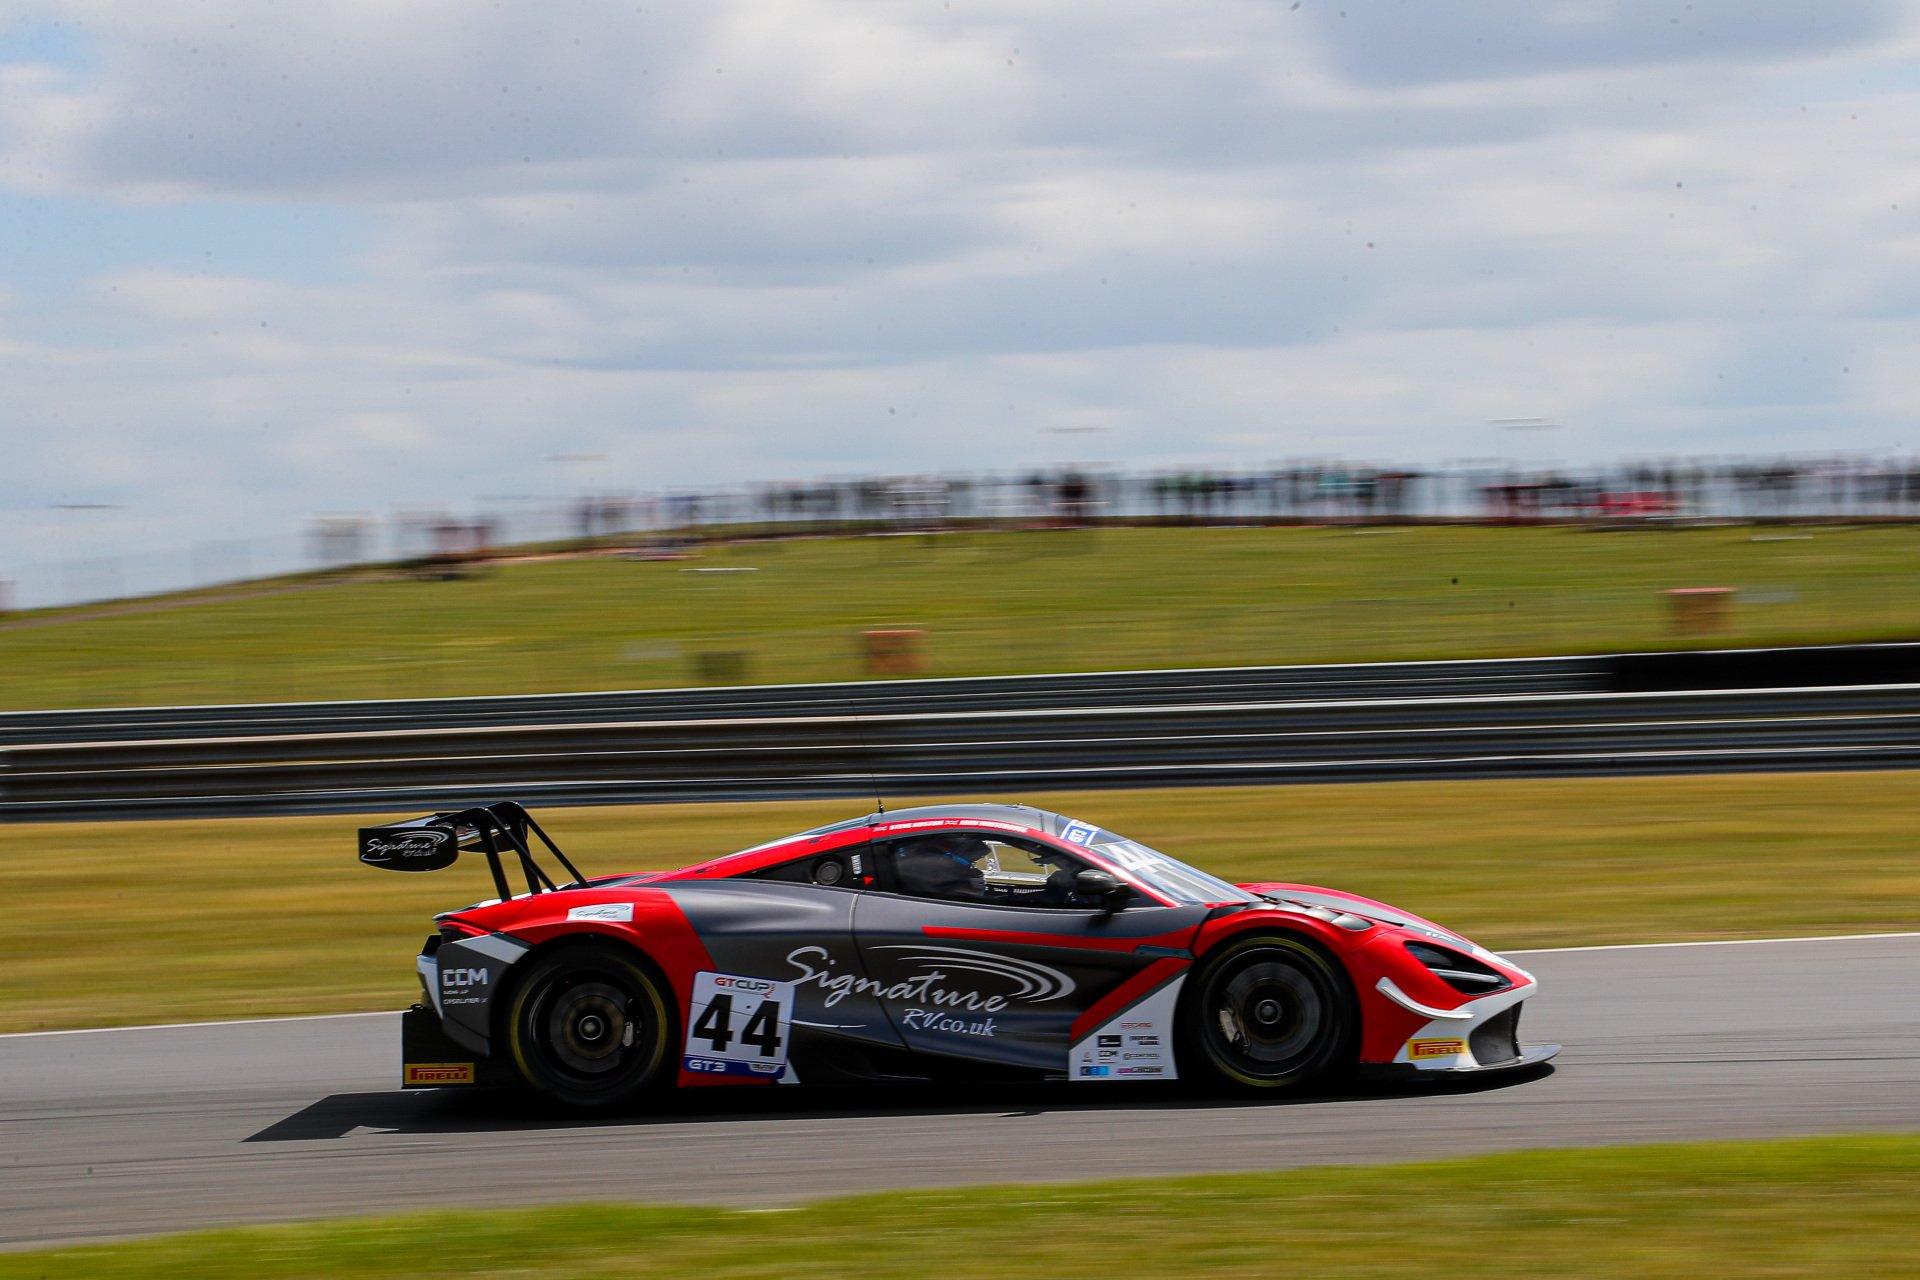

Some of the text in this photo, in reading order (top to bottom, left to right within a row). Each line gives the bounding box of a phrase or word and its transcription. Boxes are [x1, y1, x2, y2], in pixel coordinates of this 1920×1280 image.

[366, 838, 432, 856] Signature
[786, 945, 1008, 1013] Signature
[692, 993, 782, 1057] 44
[903, 1008, 998, 1037] RV.co.uk
[1413, 1041, 1464, 1057] PIRELLI
[410, 1066, 469, 1081] PIRELLI
[688, 1059, 727, 1072] GT3
